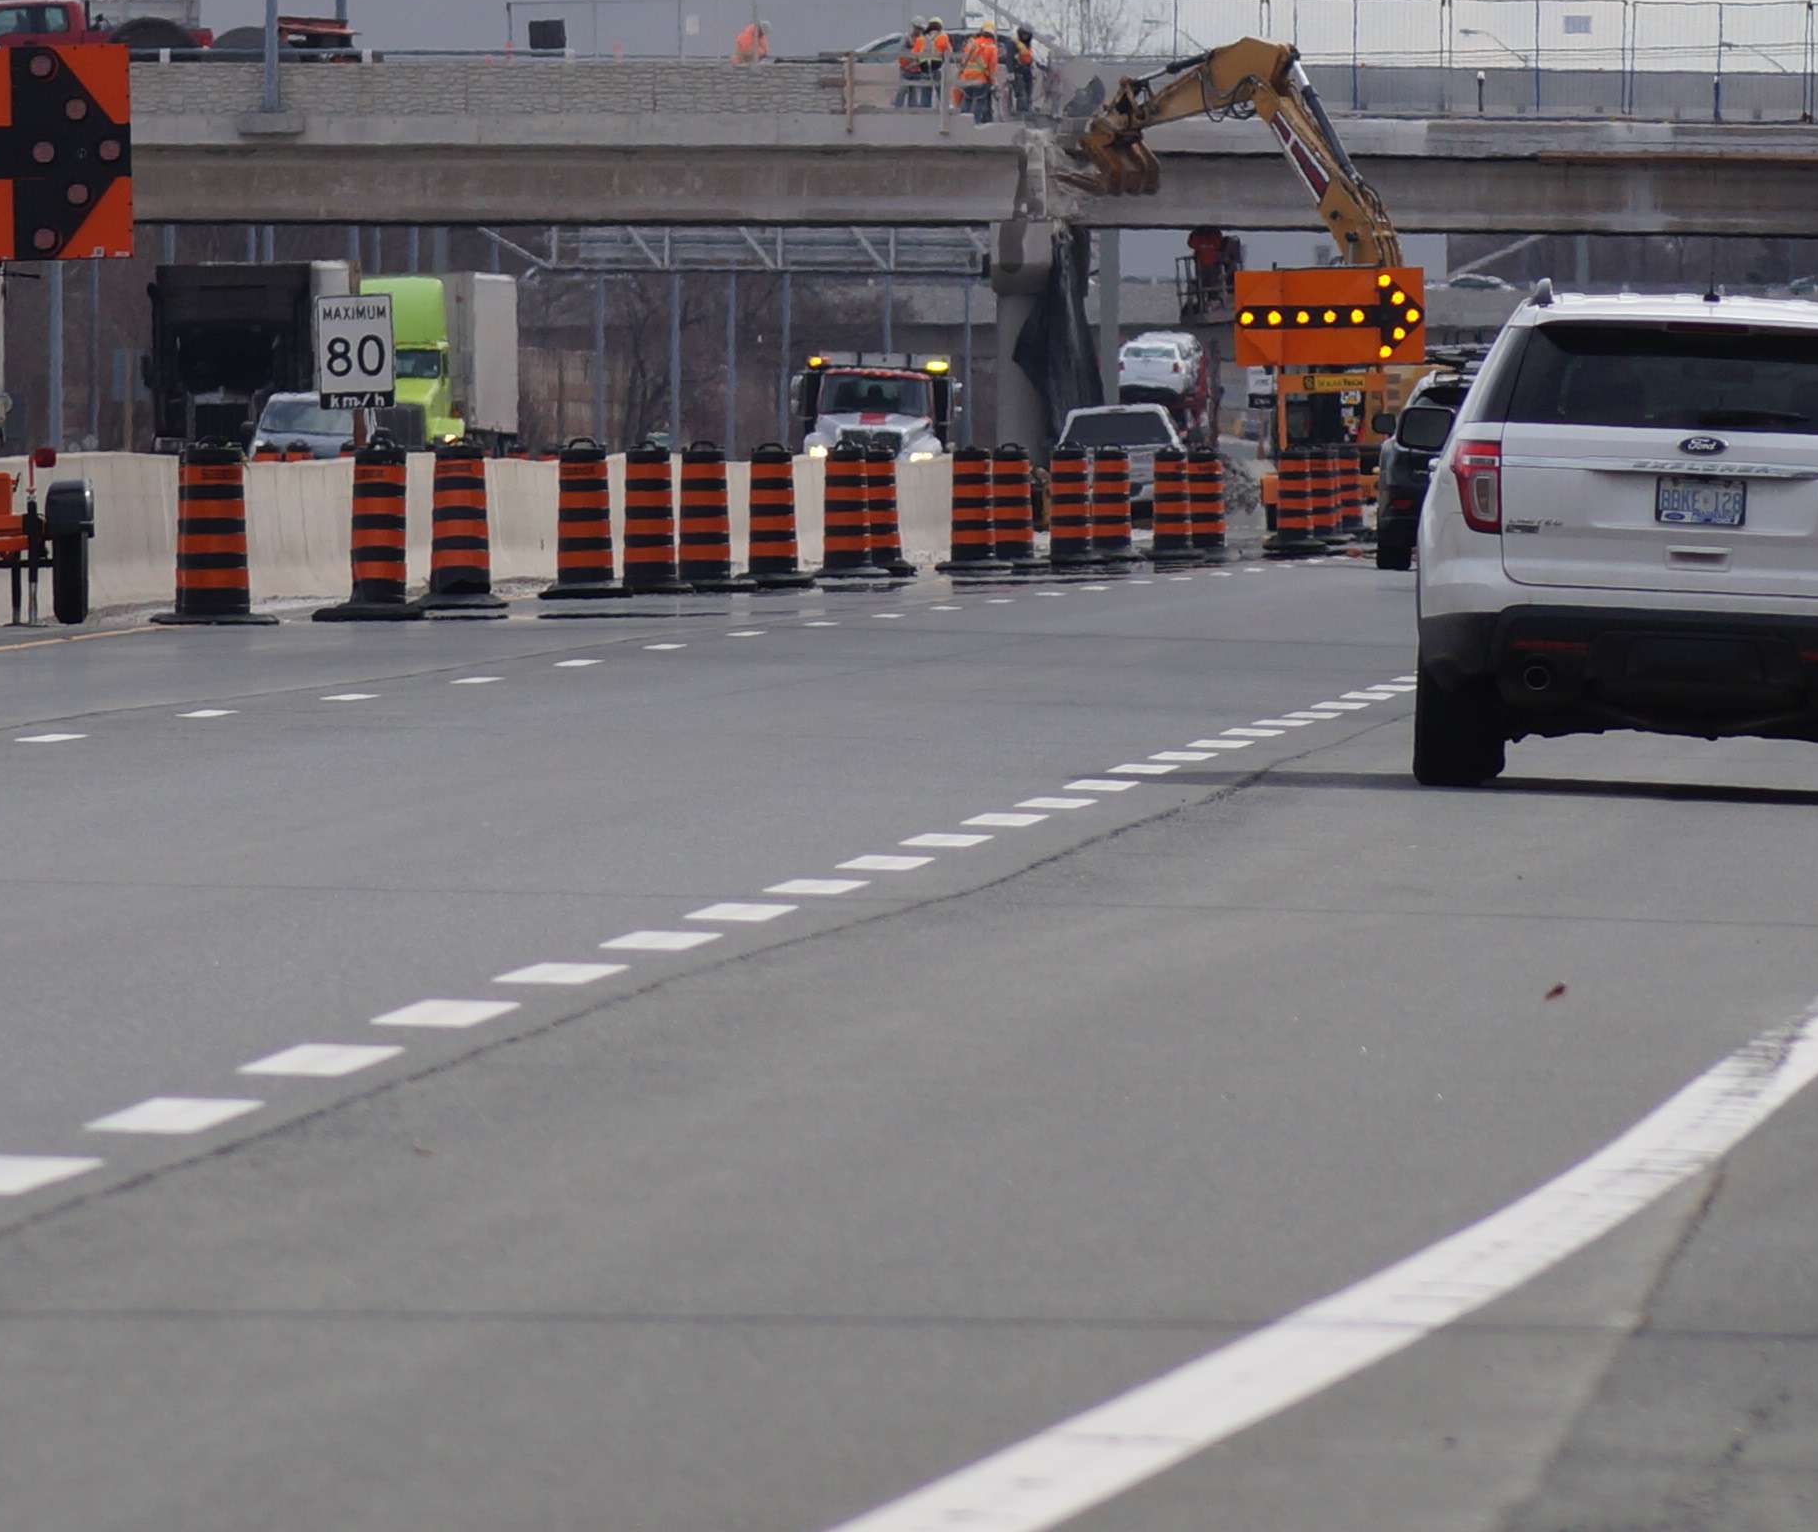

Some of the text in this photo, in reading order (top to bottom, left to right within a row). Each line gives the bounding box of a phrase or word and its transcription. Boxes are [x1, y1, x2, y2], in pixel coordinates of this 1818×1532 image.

[322, 306, 387, 321] MAXIMUM
[327, 334, 386, 378] 80
[330, 392, 386, 408] km/h
[1686, 438, 1716, 451] Ford
